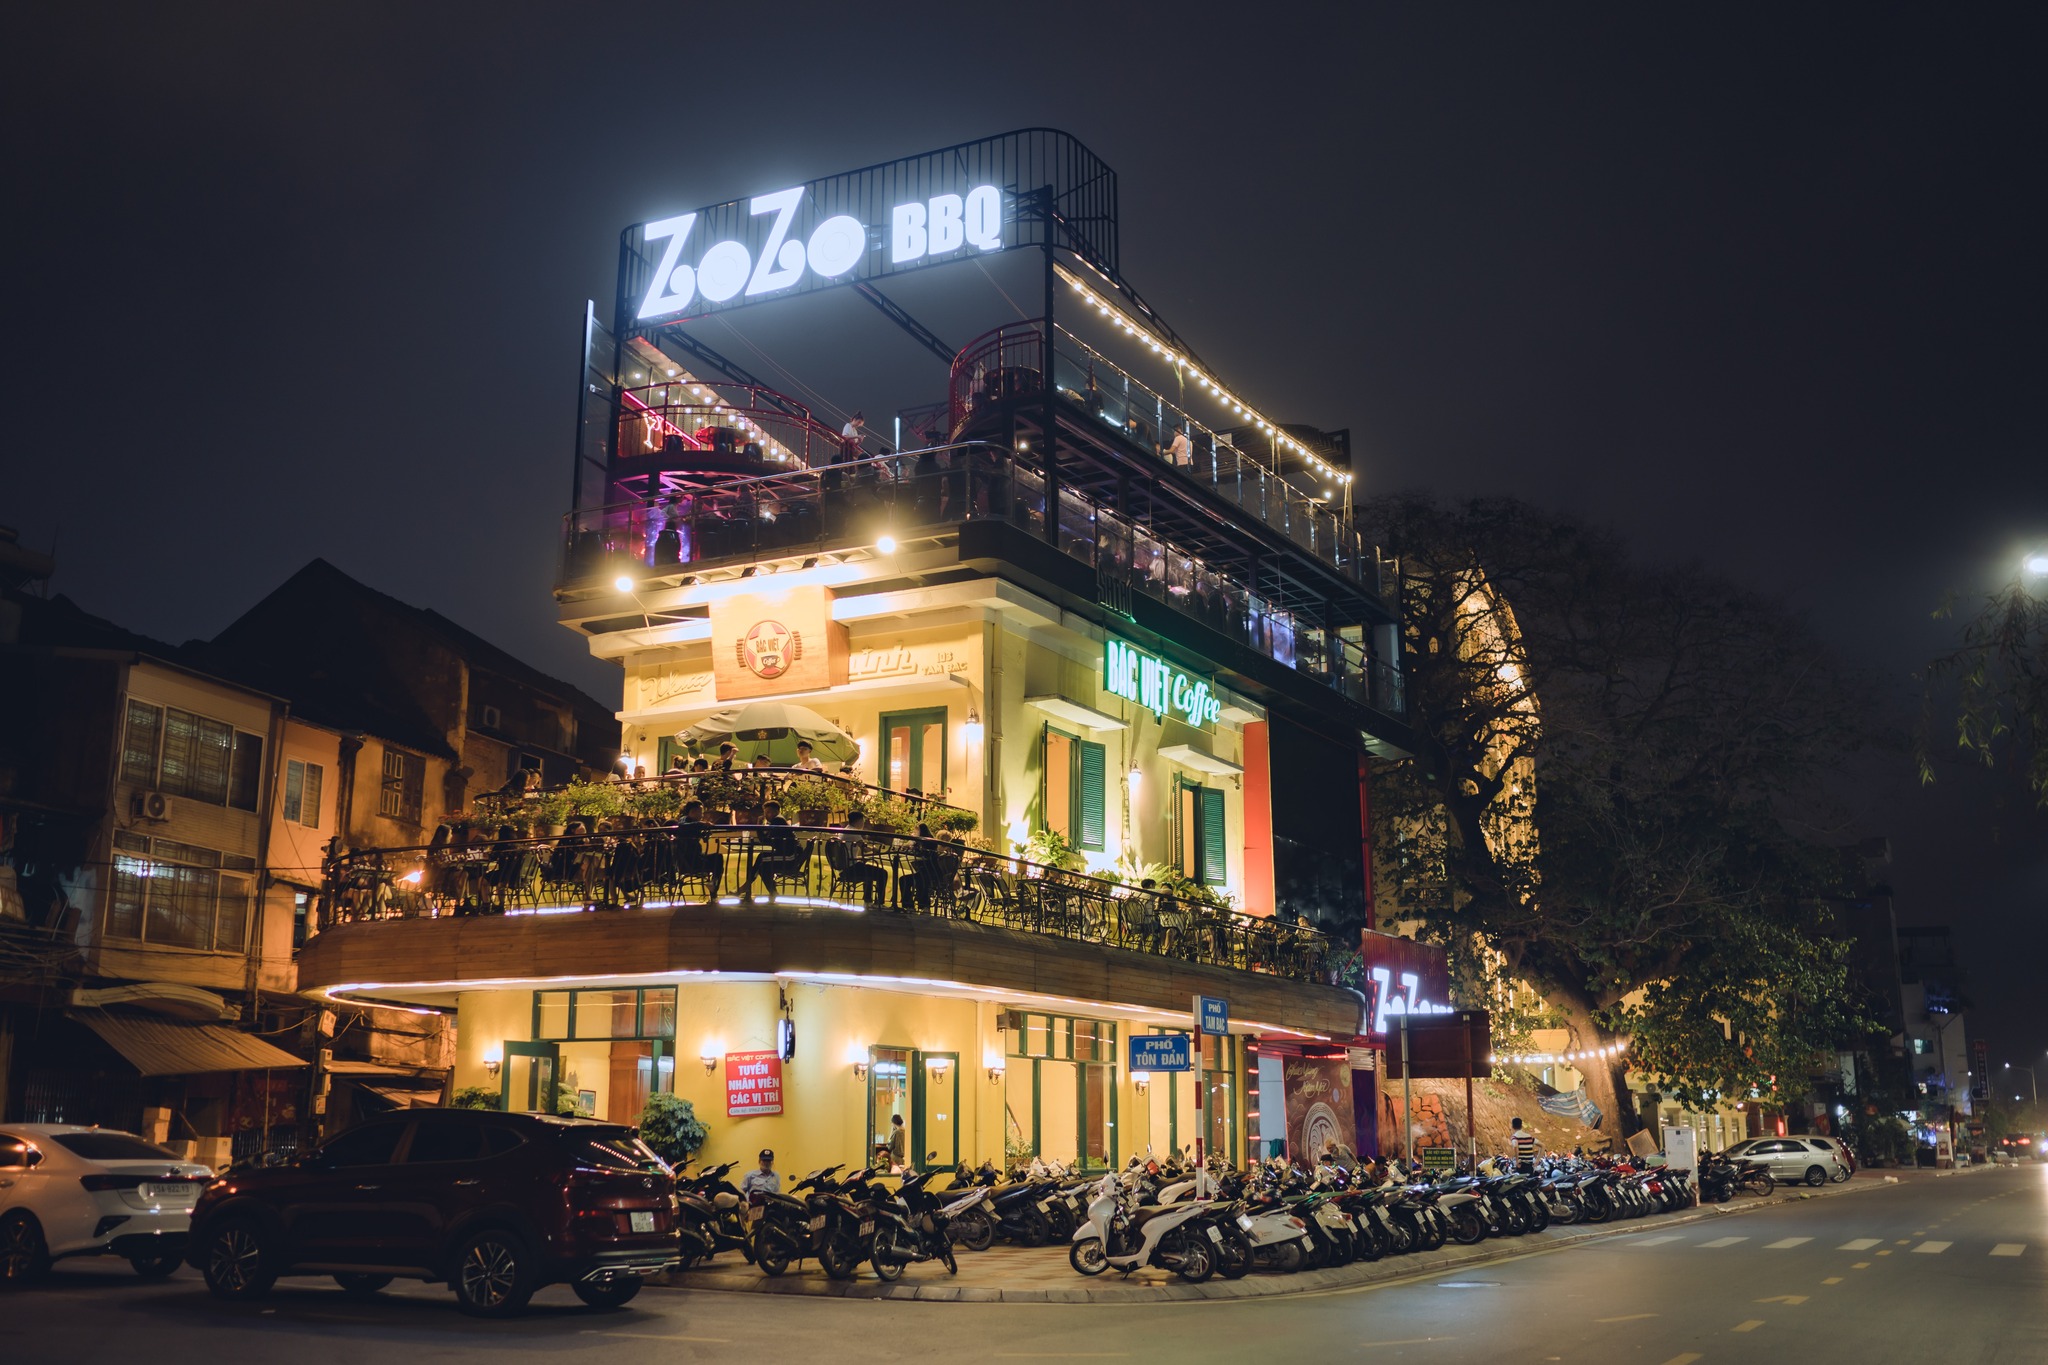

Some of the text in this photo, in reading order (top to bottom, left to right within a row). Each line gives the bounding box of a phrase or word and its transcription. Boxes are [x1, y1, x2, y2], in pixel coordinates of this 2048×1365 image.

[637, 185, 1001, 319] ZoZo BBQ
[1107, 640, 1221, 728] BẮC VIỆT Coffee
[1205, 1015, 1215, 1030] TAM
[1145, 1037, 1174, 1050] PHỐ
[1135, 1049, 1185, 1066] TÔN ĐẢN
[728, 1076, 779, 1091] NHÂN VIÊN
[730, 1090, 779, 1105] CÁC VỊ TRÍ
